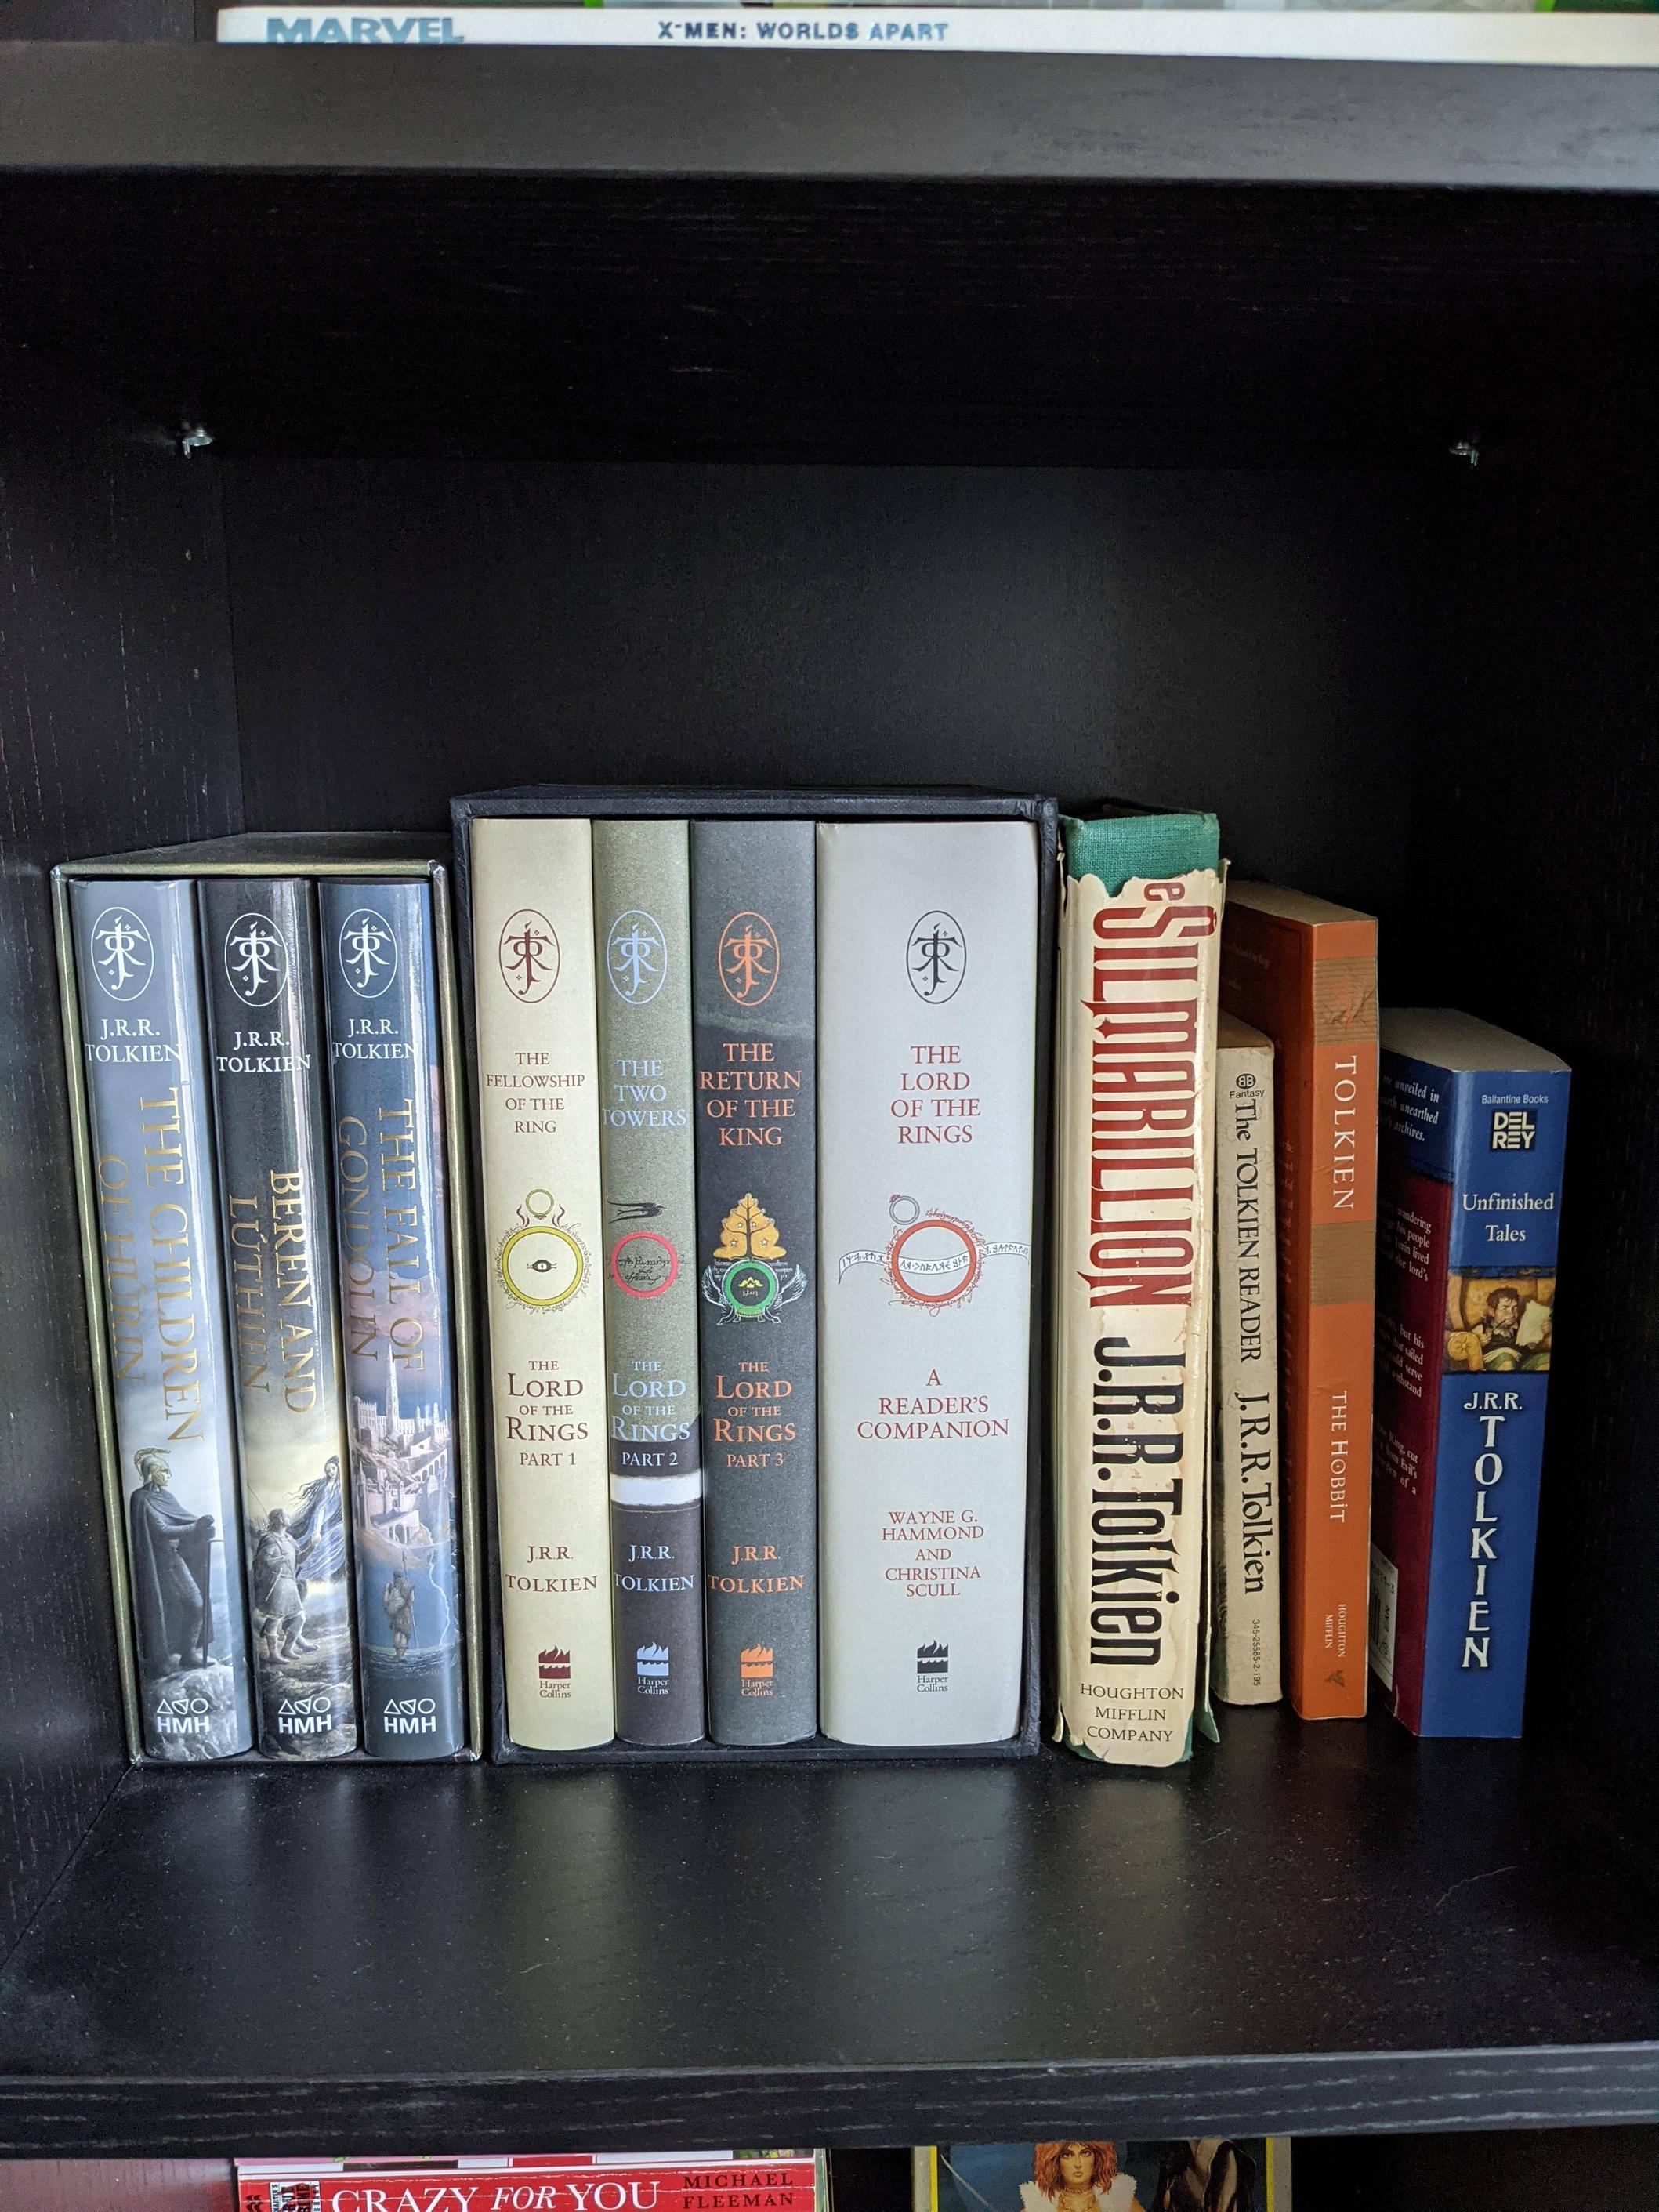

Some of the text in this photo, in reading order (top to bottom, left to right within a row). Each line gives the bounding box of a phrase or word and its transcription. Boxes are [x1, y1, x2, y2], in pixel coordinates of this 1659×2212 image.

[267, 18, 465, 44] MARVEL
[657, 21, 949, 42] X-MEN: WORLDS APART
[100, 1018, 161, 1041] J.R.R.
[348, 1018, 399, 1039] J.R.R.
[234, 1031, 291, 1050] J.R.R.
[85, 1043, 182, 1063] TOLKIEN
[333, 1042, 420, 1060] TOLKIEN
[515, 1053, 550, 1065] THE
[723, 1043, 775, 1062] THE
[910, 1045, 962, 1065] THE
[216, 1054, 311, 1073] TOLKIEN
[616, 1060, 663, 1077] THE
[486, 1074, 585, 1088] FELLOWSHIP
[700, 1070, 801, 1091] RETURN
[900, 1072, 970, 1091] LORD
[614, 1085, 667, 1102] TWO
[1229, 1090, 1265, 1099] Fantasy
[1395, 1079, 1428, 1099] unveiled
[1430, 1088, 1440, 1104] in
[1481, 1094, 1549, 1104] Ballantine Books
[505, 1097, 564, 1111] OF THE
[707, 1099, 796, 1119] OF THE
[890, 1097, 981, 1119] OF THE
[603, 1109, 686, 1127] TOWERS
[1400, 1103, 1440, 1125] unearthed
[1493, 1111, 1535, 1130] DEL
[514, 1120, 557, 1134] RING
[718, 1127, 783, 1146] KING
[897, 1124, 973, 1144] RINGS
[1332, 1054, 1358, 1210] TOLKIEN
[1393, 1121, 1425, 1141] archives.
[1492, 1131, 1535, 1149] REY
[98, 1155, 133, 1218] OF
[1462, 1192, 1555, 1211] Unfinished
[1235, 1098, 1262, 1363] The TOLKIEN READER
[1397, 1207, 1433, 1235] wandering
[339, 1115, 379, 1361] GONDOLIN
[379, 1098, 425, 1372] THE FALL OF
[1396, 1220, 1406, 1235] his
[1407, 1230, 1431, 1248] people
[1485, 1224, 1527, 1242] Tales
[139, 1088, 205, 1441] THE CHILDREN
[1412, 1246, 1429, 1265] lived
[1409, 1261, 1429, 1282] lord's
[230, 1194, 270, 1394] LÚTHIEN
[270, 1169, 317, 1412] BEREN AND
[1400, 1323, 1411, 1340] but
[1414, 1333, 1425, 1349] his
[528, 1360, 560, 1371] THE
[1405, 1347, 1423, 1365] sailed
[632, 1360, 662, 1372] THE
[738, 1361, 769, 1373] THE
[1405, 1364, 1422, 1381] serve
[507, 1373, 584, 1398] LORD
[611, 1373, 686, 1398] LORD
[715, 1375, 793, 1399] LORD
[925, 1369, 943, 1387] A
[878, 1396, 989, 1415] READER'S
[1463, 1391, 1523, 1410] J.R.R.
[519, 1405, 573, 1416] OF THE
[621, 1405, 676, 1416] OF THE
[727, 1405, 781, 1416] OF THE
[506, 1416, 589, 1441] RINGS
[610, 1416, 690, 1442] RINGS
[713, 1418, 796, 1443] RINGS
[857, 1418, 1010, 1440] COMPANION
[520, 1452, 577, 1467] PART 1
[621, 1452, 679, 1467] PART 2
[726, 1452, 784, 1467] PART 3
[1329, 1390, 1349, 1523] THE HOBBIT
[1407, 1450, 1418, 1463] cut
[1400, 1457, 1418, 1479] Evil's
[1234, 1391, 1273, 1595] J.R.R. Tolkien
[1400, 1477, 1417, 1496] of a
[888, 1510, 978, 1525] WAYNE G.
[882, 1525, 984, 1542] HAMMOND
[1461, 1415, 1506, 1669] TOLKIEN
[527, 1546, 574, 1564] J.R.R.
[628, 1544, 675, 1563] J.R.R.
[731, 1546, 781, 1565] J.R.R.
[915, 1548, 951, 1561] AND
[505, 1574, 598, 1593] TOLKIEN
[614, 1574, 695, 1593] TOLKIEN
[885, 1566, 981, 1582] CHRISTINA
[708, 1574, 805, 1594] TOLKIEN
[906, 1583, 961, 1597] SCULL
[1324, 1614, 1334, 1649] MIFFLIN
[1337, 1604, 1347, 1658] HOUGHTON
[539, 1681, 571, 1691] Harper
[637, 1676, 669, 1687] Harper
[741, 1678, 773, 1689] Harper
[917, 1675, 948, 1685] Harper
[917, 1683, 948, 1692] Collins
[539, 1689, 571, 1699] Collins
[637, 1685, 669, 1695] Collins
[741, 1687, 773, 1697] Collins
[1080, 1683, 1185, 1700] HOUGHTON
[1094, 1705, 1167, 1721] MIFFLIN
[157, 1716, 210, 1734] HMH
[278, 1714, 332, 1735] HMH
[384, 1715, 436, 1734] HMH
[1087, 1725, 1174, 1742] COMPANY
[683, 2172, 793, 2189] MICHAEL
[281, 2185, 296, 2212] RUE
[331, 2181, 661, 2212] CRAZY FOR YOU
[683, 2192, 794, 2210] FLEEMAN
